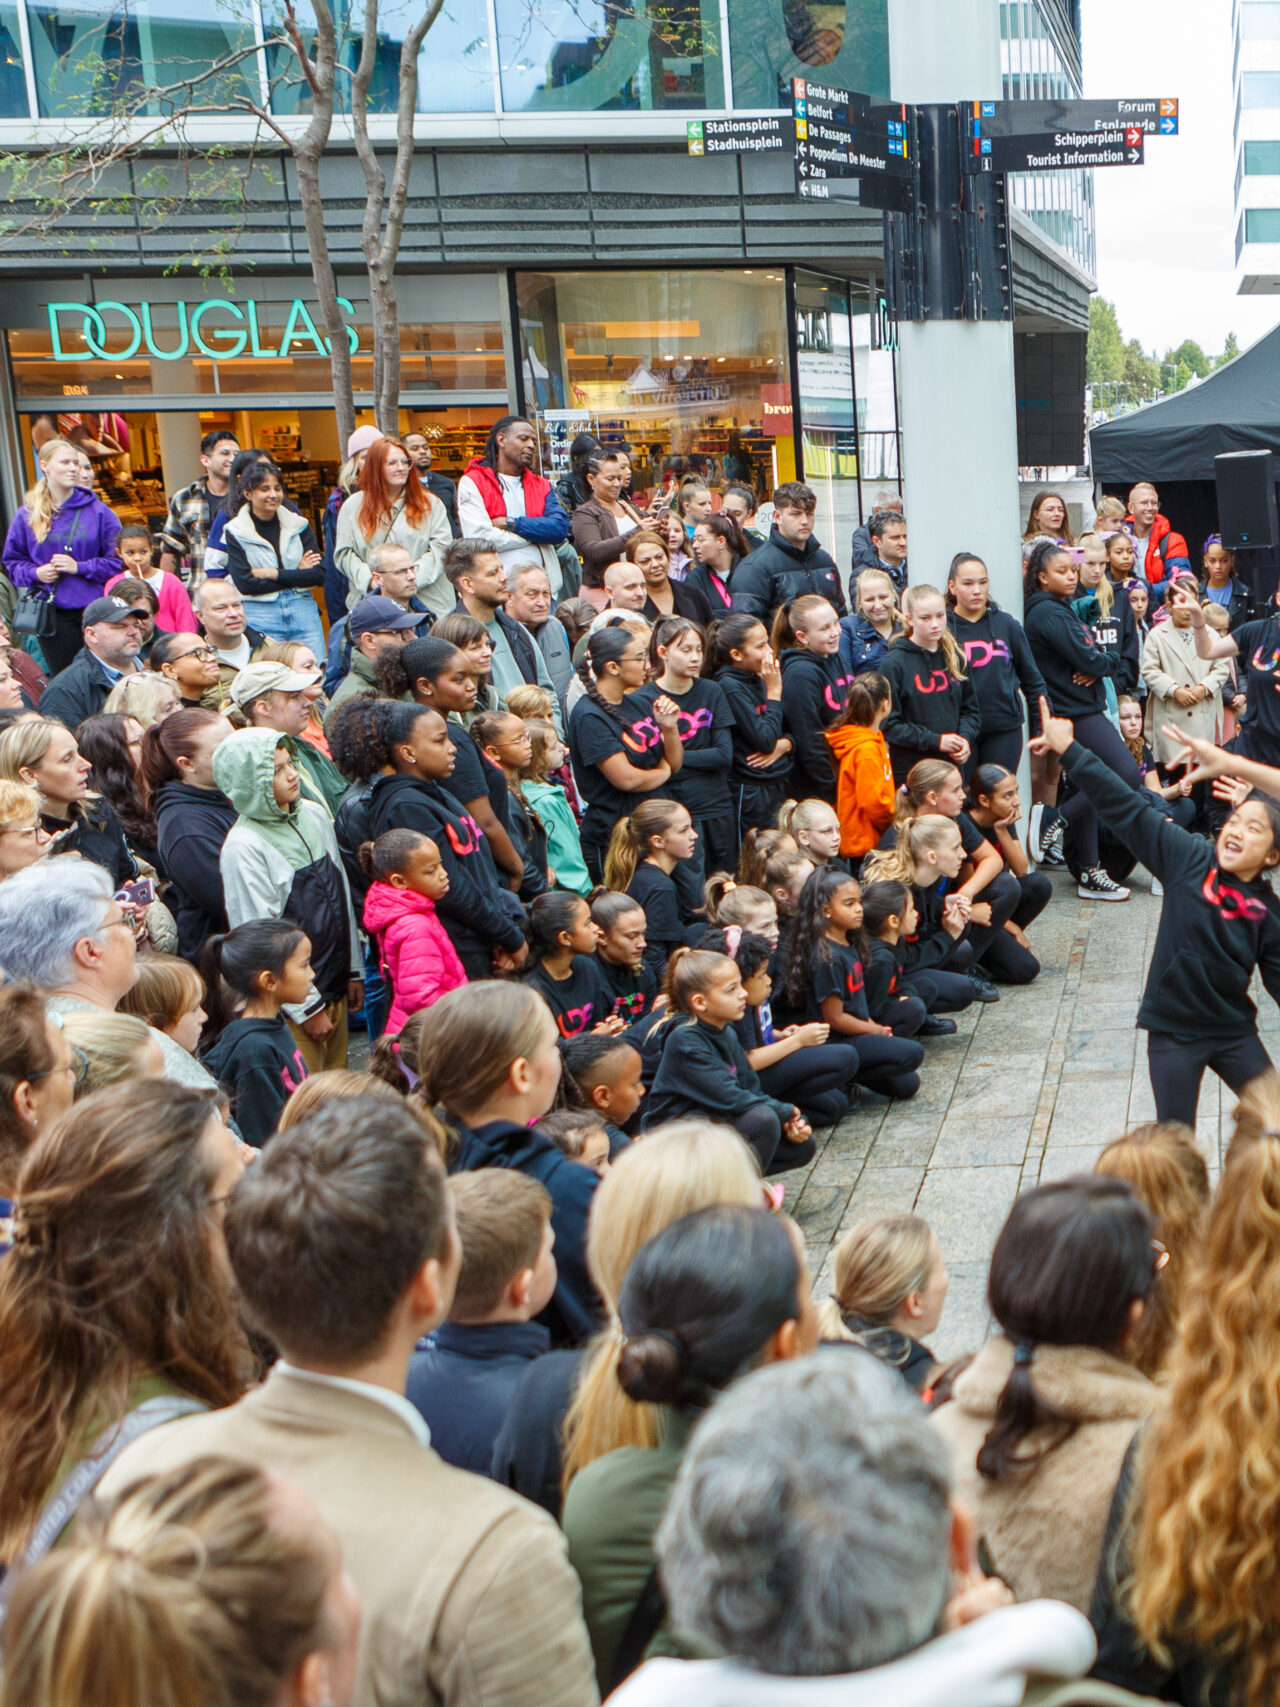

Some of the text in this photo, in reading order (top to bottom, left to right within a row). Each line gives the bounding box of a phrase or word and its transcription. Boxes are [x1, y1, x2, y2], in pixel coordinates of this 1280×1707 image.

[806, 83, 849, 104] Grote Markt
[807, 103, 833, 120] Belfort
[1118, 101, 1156, 113] Forum
[706, 118, 780, 134] Stationsplein
[808, 123, 852, 144] De Passages
[707, 135, 783, 152] Stadhuisplein
[1055, 130, 1124, 148] Schipperplein
[809, 145, 887, 170] Poppodium De Meester
[1027, 151, 1124, 167] Tourist Information
[810, 164, 827, 179] Zara
[811, 183, 829, 198] H&M
[48, 296, 360, 361] DOUGLAS
